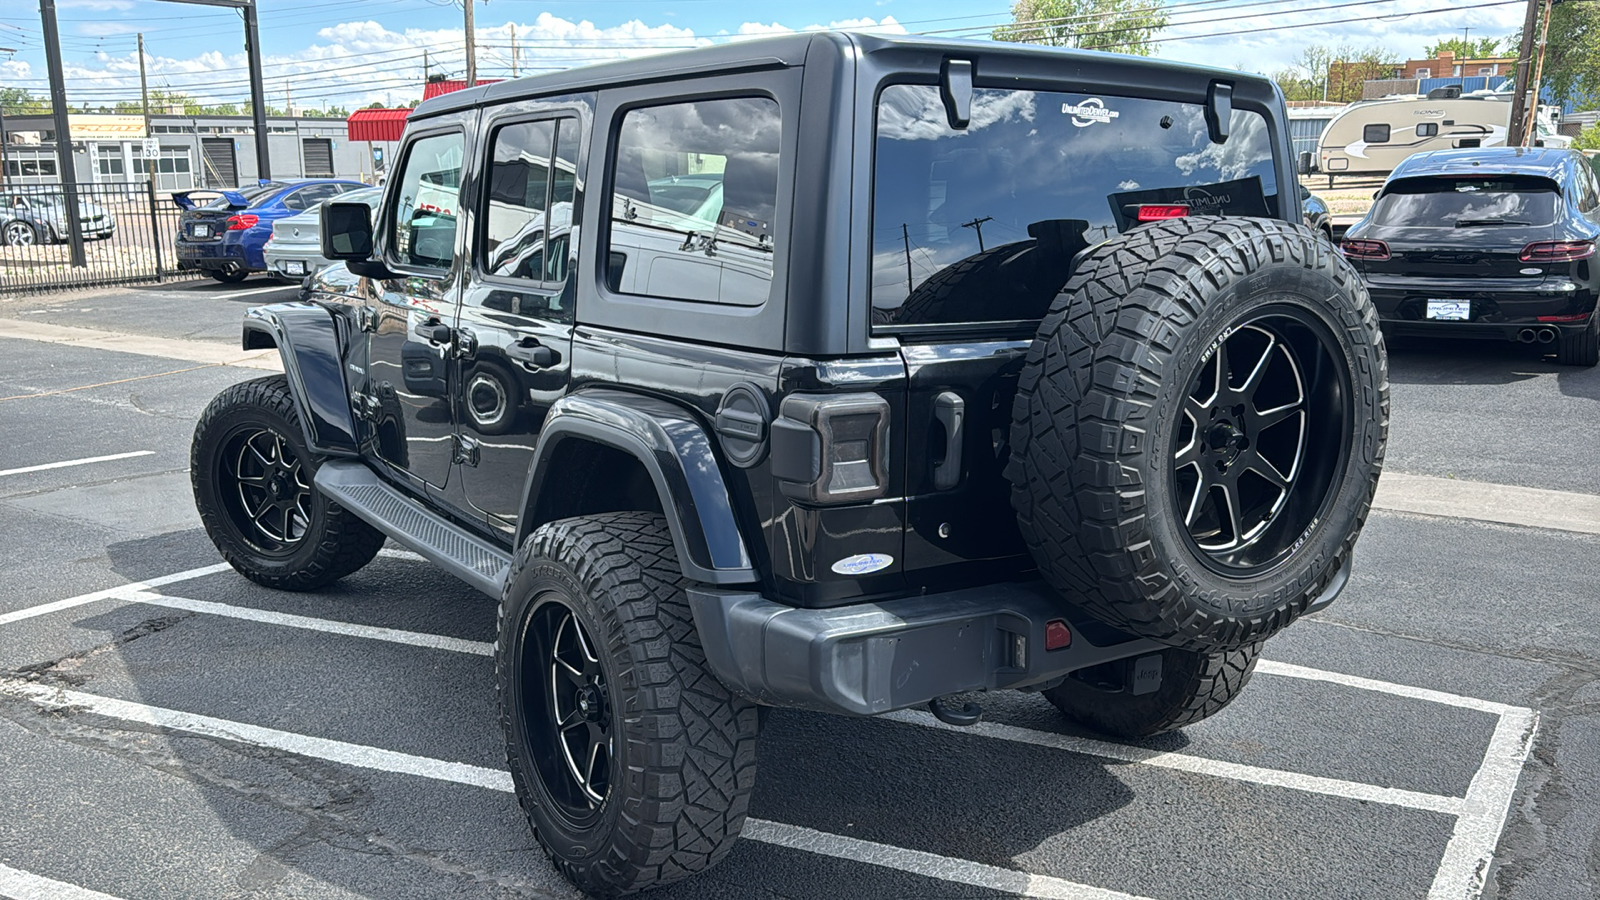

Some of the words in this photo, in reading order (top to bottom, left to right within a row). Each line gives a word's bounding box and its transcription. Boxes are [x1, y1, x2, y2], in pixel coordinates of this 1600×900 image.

[145, 149, 159, 158] 30
[1326, 293, 1377, 466] NITTO
[1169, 558, 1271, 613] GRAPPLER
[1272, 542, 1327, 606] RIDGE
[1137, 669, 1158, 680] Jeep
